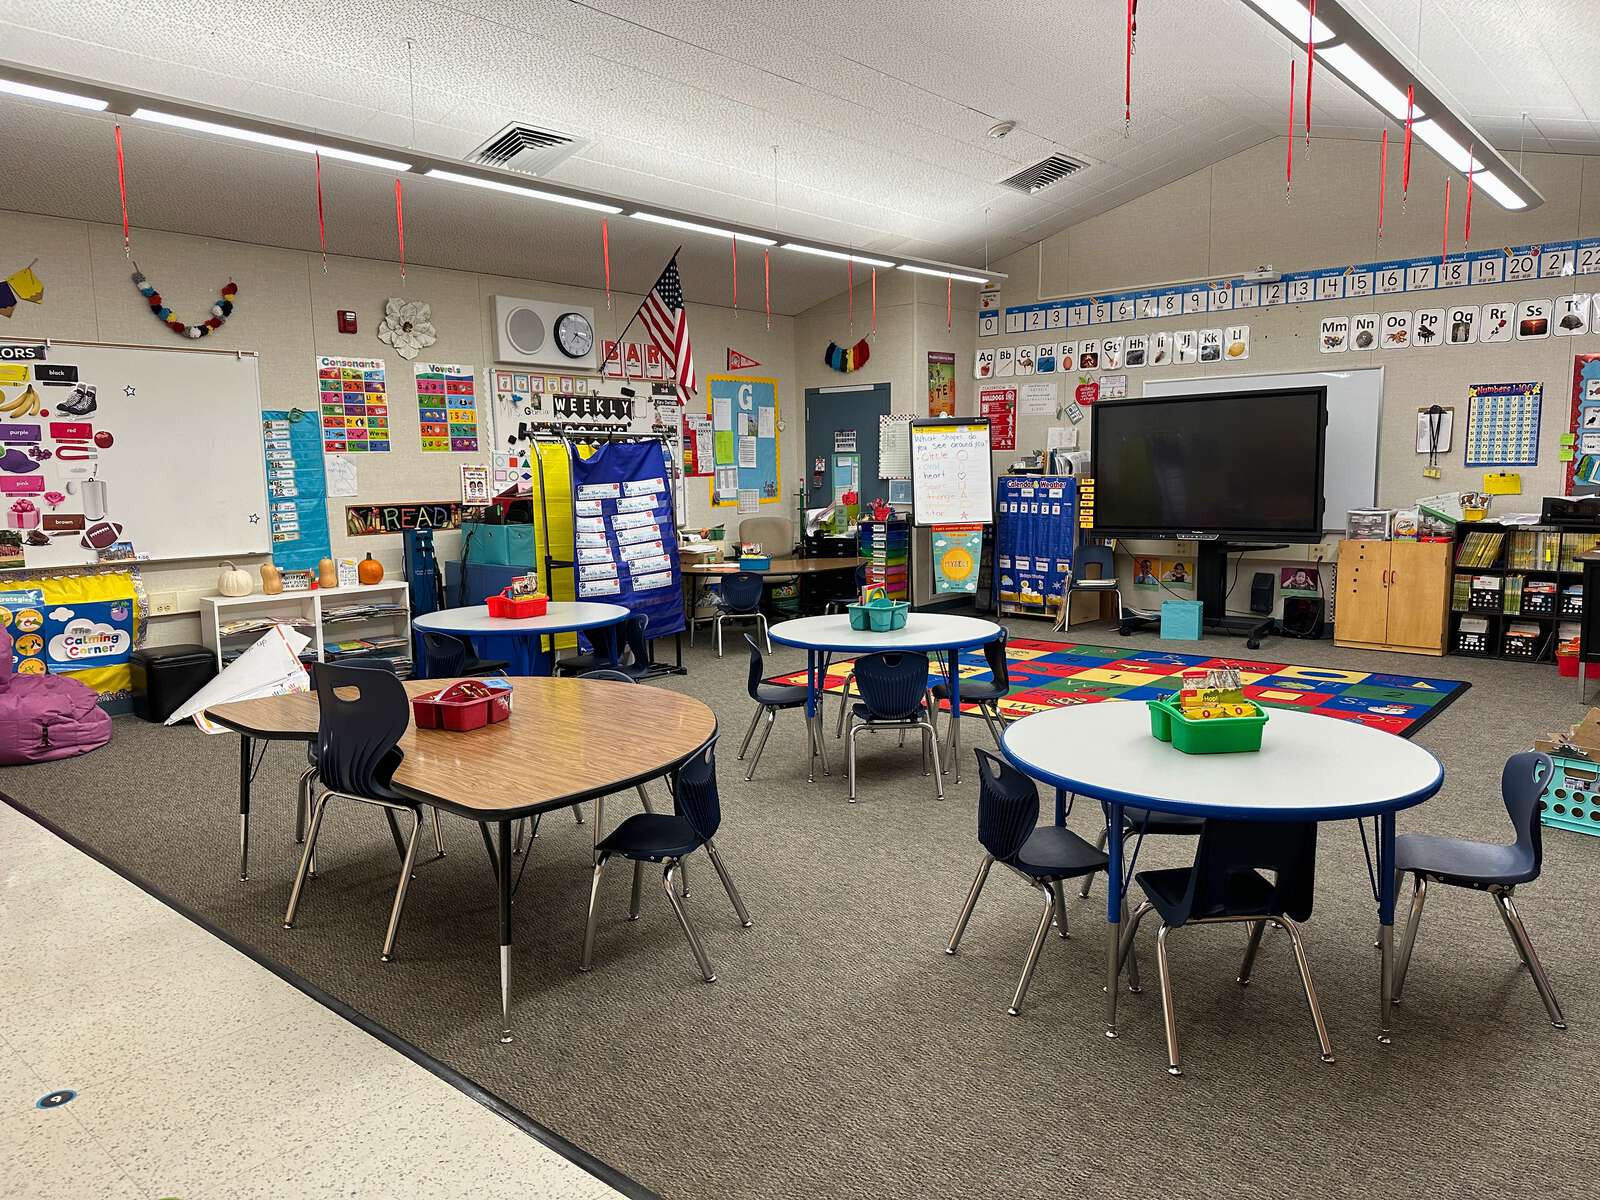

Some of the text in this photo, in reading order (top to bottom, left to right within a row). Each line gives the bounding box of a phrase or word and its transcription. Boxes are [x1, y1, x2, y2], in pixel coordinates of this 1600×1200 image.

[985, 319, 992, 330] 0
[1033, 313, 1039, 325] 2
[1053, 310, 1060, 322] 3
[1075, 308, 1081, 320] 4
[1097, 305, 1104, 317] 5
[1119, 303, 1127, 315] 6
[1143, 300, 1150, 312] 7
[1166, 296, 1174, 309] 8
[1192, 294, 1199, 306] 9
[1213, 291, 1228, 304] 10
[1241, 288, 1252, 302] 11
[1266, 285, 1280, 299] 12
[1294, 282, 1308, 296] 13
[1323, 279, 1338, 293] 14
[1352, 275, 1367, 290] 15
[1382, 272, 1397, 286] 16
[1413, 268, 1429, 283] 17
[1444, 265, 1462, 280] 18
[1480, 261, 1494, 277] 19
[1510, 257, 1533, 274] 20
[1549, 253, 1566, 270] 21
[1322, 322, 1347, 333] Mm
[1356, 319, 1374, 330] Nn
[1387, 317, 1406, 327] Oo
[1421, 314, 1438, 326] Pp
[1453, 311, 1473, 323] Qq
[1490, 308, 1506, 319] Rr
[1526, 305, 1542, 316] Ss
[979, 353, 992, 361] Aa
[1000, 351, 1011, 360] Bb
[1021, 350, 1031, 358] Cc
[1041, 346, 1052, 356] Dd
[1062, 346, 1073, 354] Ee
[1085, 342, 1094, 352] Ff
[1130, 339, 1143, 349] Hh
[1158, 337, 1164, 348] Ii
[1182, 335, 1190, 348] Jj
[1204, 333, 1217, 343] Kk
[1233, 330, 1241, 340] Ll
[322, 358, 381, 368] Consonants
[49, 369, 65, 377] black
[429, 365, 461, 373] Vowels
[1477, 384, 1533, 394] Numbers 1-100
[738, 384, 753, 411] G
[554, 398, 630, 413] WEEKLY
[9, 429, 29, 437] purple
[66, 426, 77, 434] red
[923, 470, 945, 479] heart
[1040, 480, 1067, 489] Weather
[383, 506, 448, 531] READ
[72, 627, 91, 635] The
[64, 633, 120, 646] Calming
[69, 644, 115, 656] Corner
